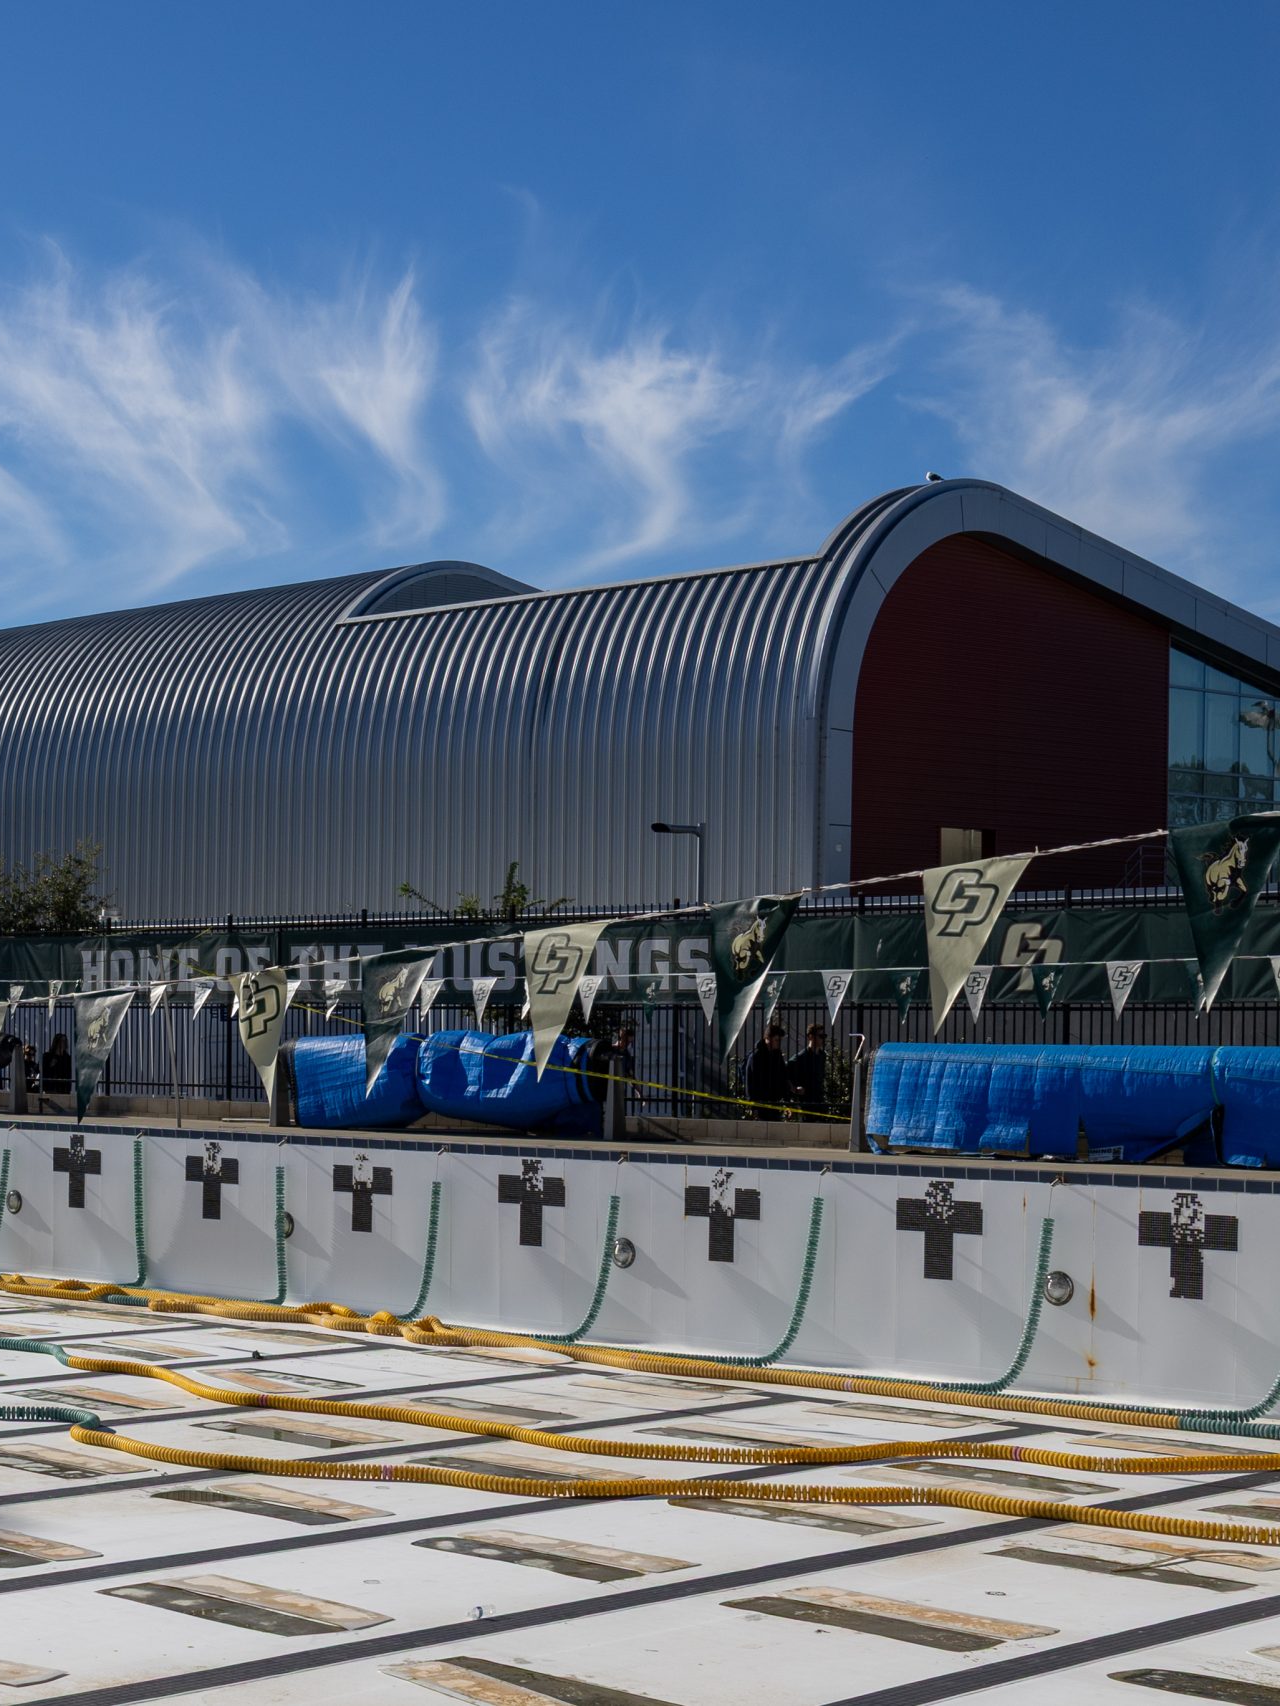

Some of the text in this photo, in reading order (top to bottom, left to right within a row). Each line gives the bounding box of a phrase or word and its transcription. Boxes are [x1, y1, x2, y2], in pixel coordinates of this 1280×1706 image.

[931, 868, 1000, 937] CP
[81, 948, 199, 991] HOME
[531, 933, 584, 995] CP
[1112, 966, 1135, 990] CP
[827, 975, 847, 997] CP
